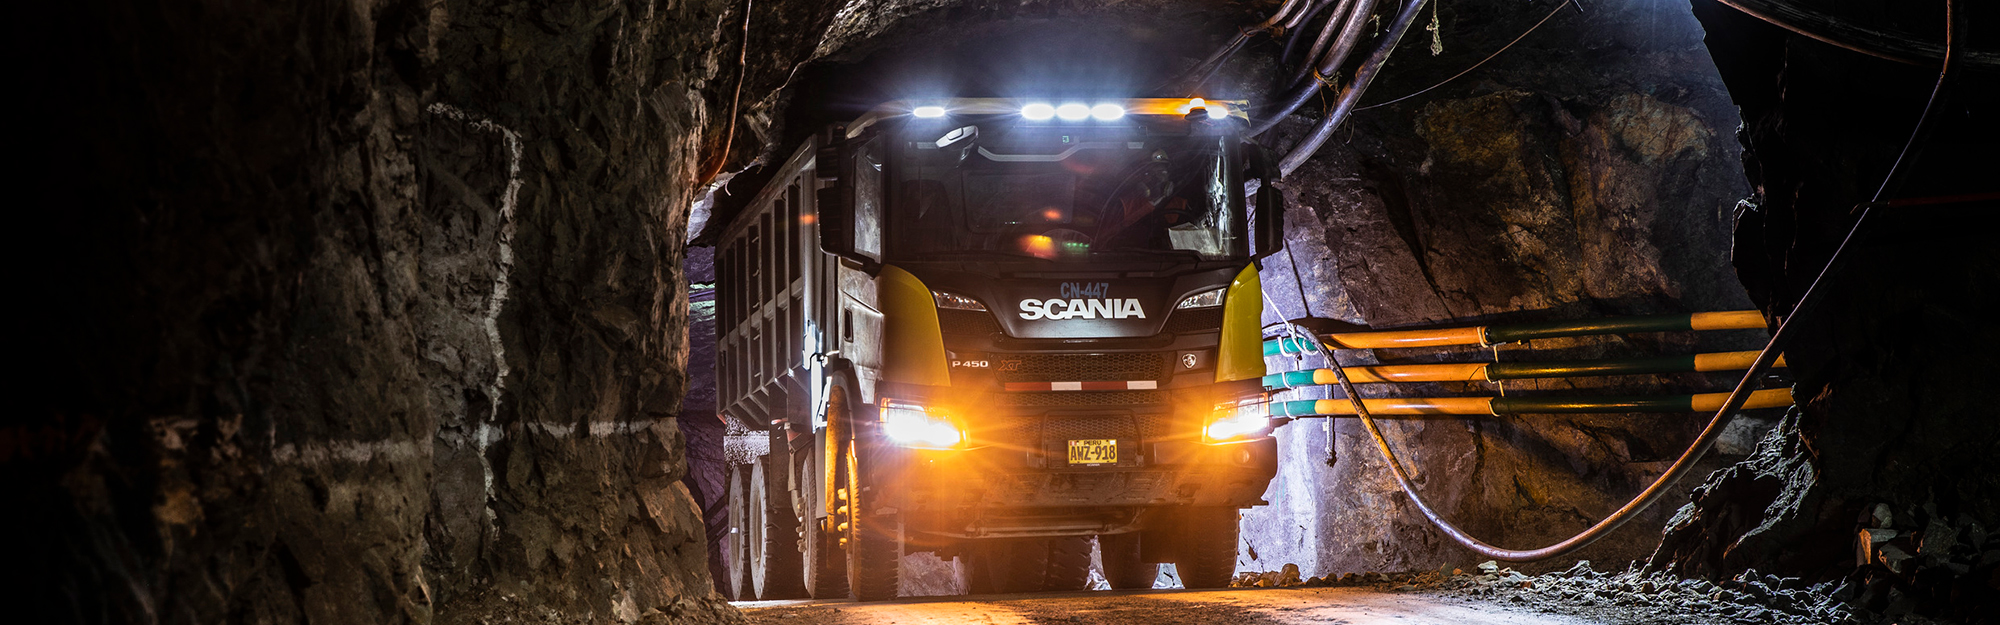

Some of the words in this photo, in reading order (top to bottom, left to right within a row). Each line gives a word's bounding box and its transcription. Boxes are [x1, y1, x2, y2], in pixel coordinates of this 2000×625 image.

[1060, 282, 1109, 298] CN-447
[1019, 298, 1146, 320] SCANIA
[998, 360, 1021, 371] XT
[1071, 446, 1115, 460] AWZ-918
